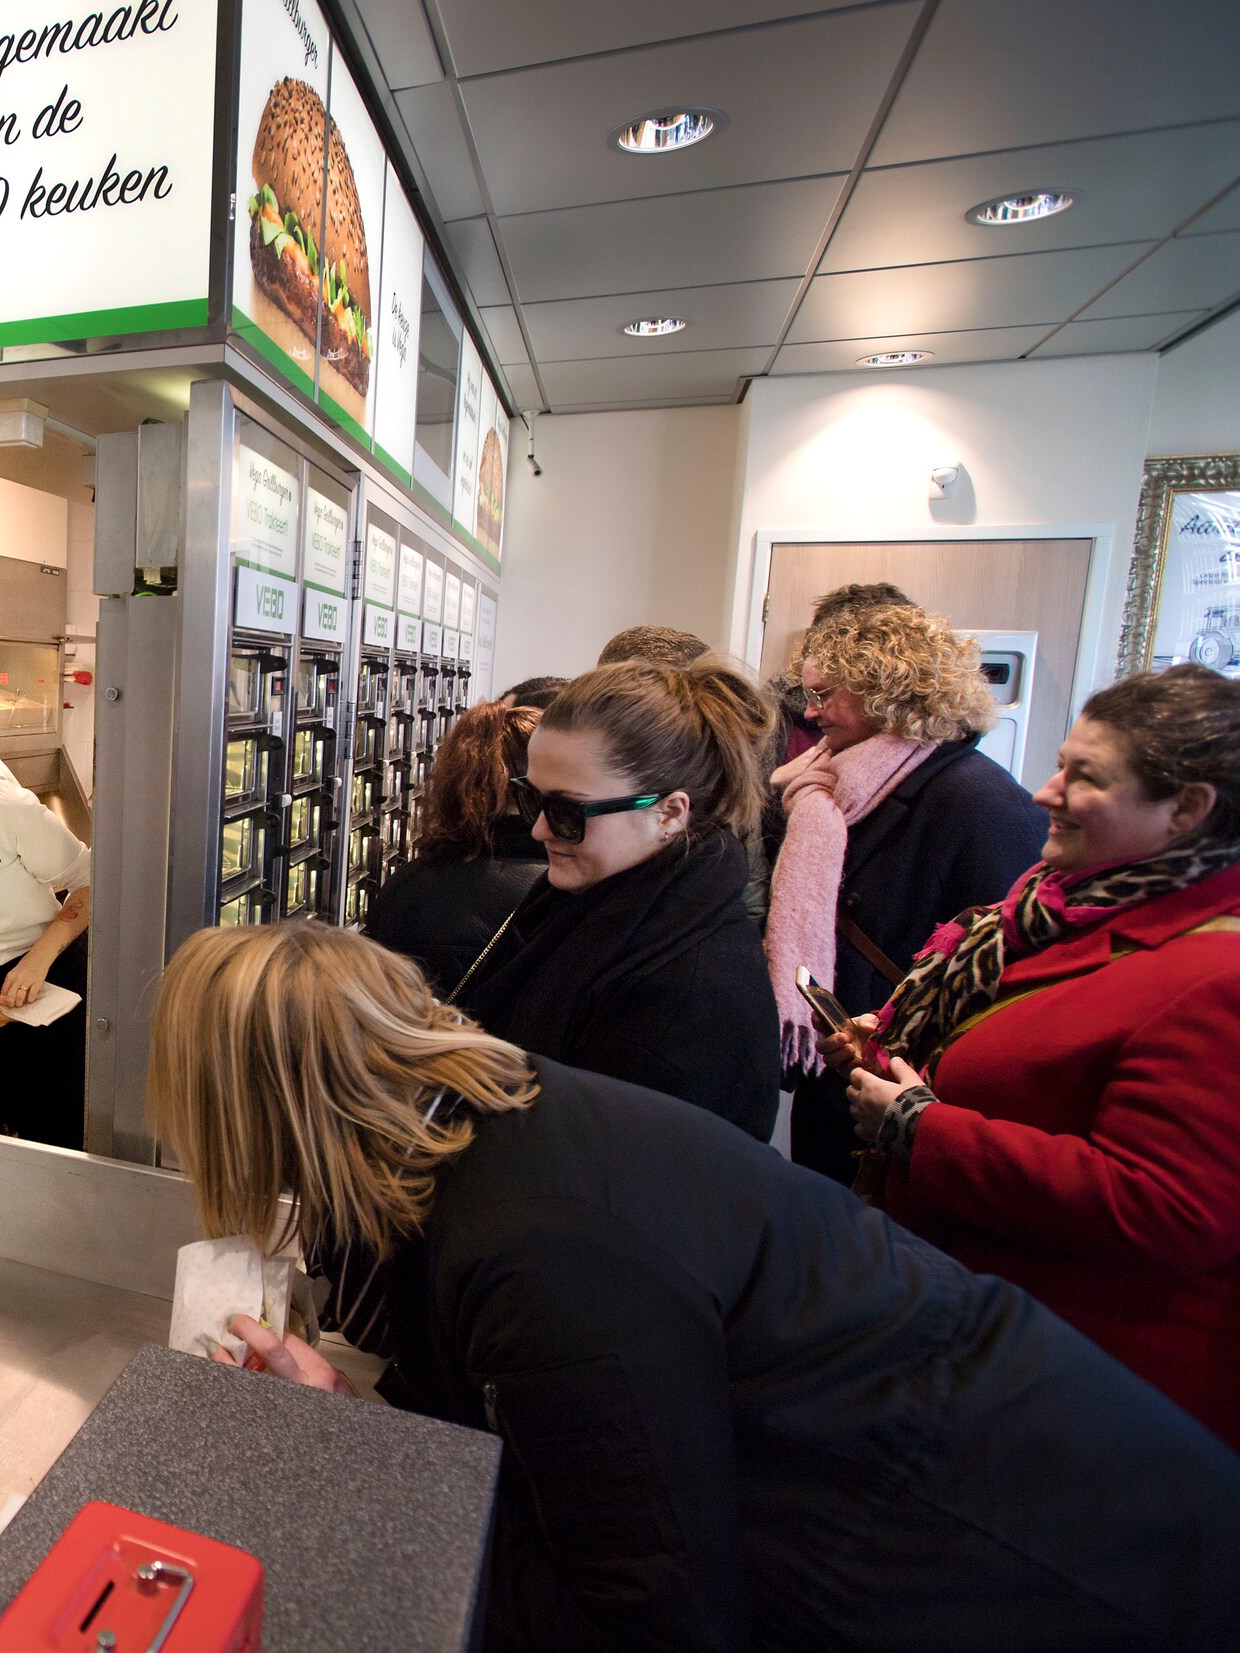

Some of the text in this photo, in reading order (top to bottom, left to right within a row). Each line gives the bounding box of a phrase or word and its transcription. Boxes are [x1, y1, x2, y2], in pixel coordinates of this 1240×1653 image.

[32, 83, 85, 140] de
[20, 152, 174, 221] keuken
[256, 583, 285, 620] VEBO
[318, 602, 338, 631] VEBO
[374, 615, 389, 639] VEBO
